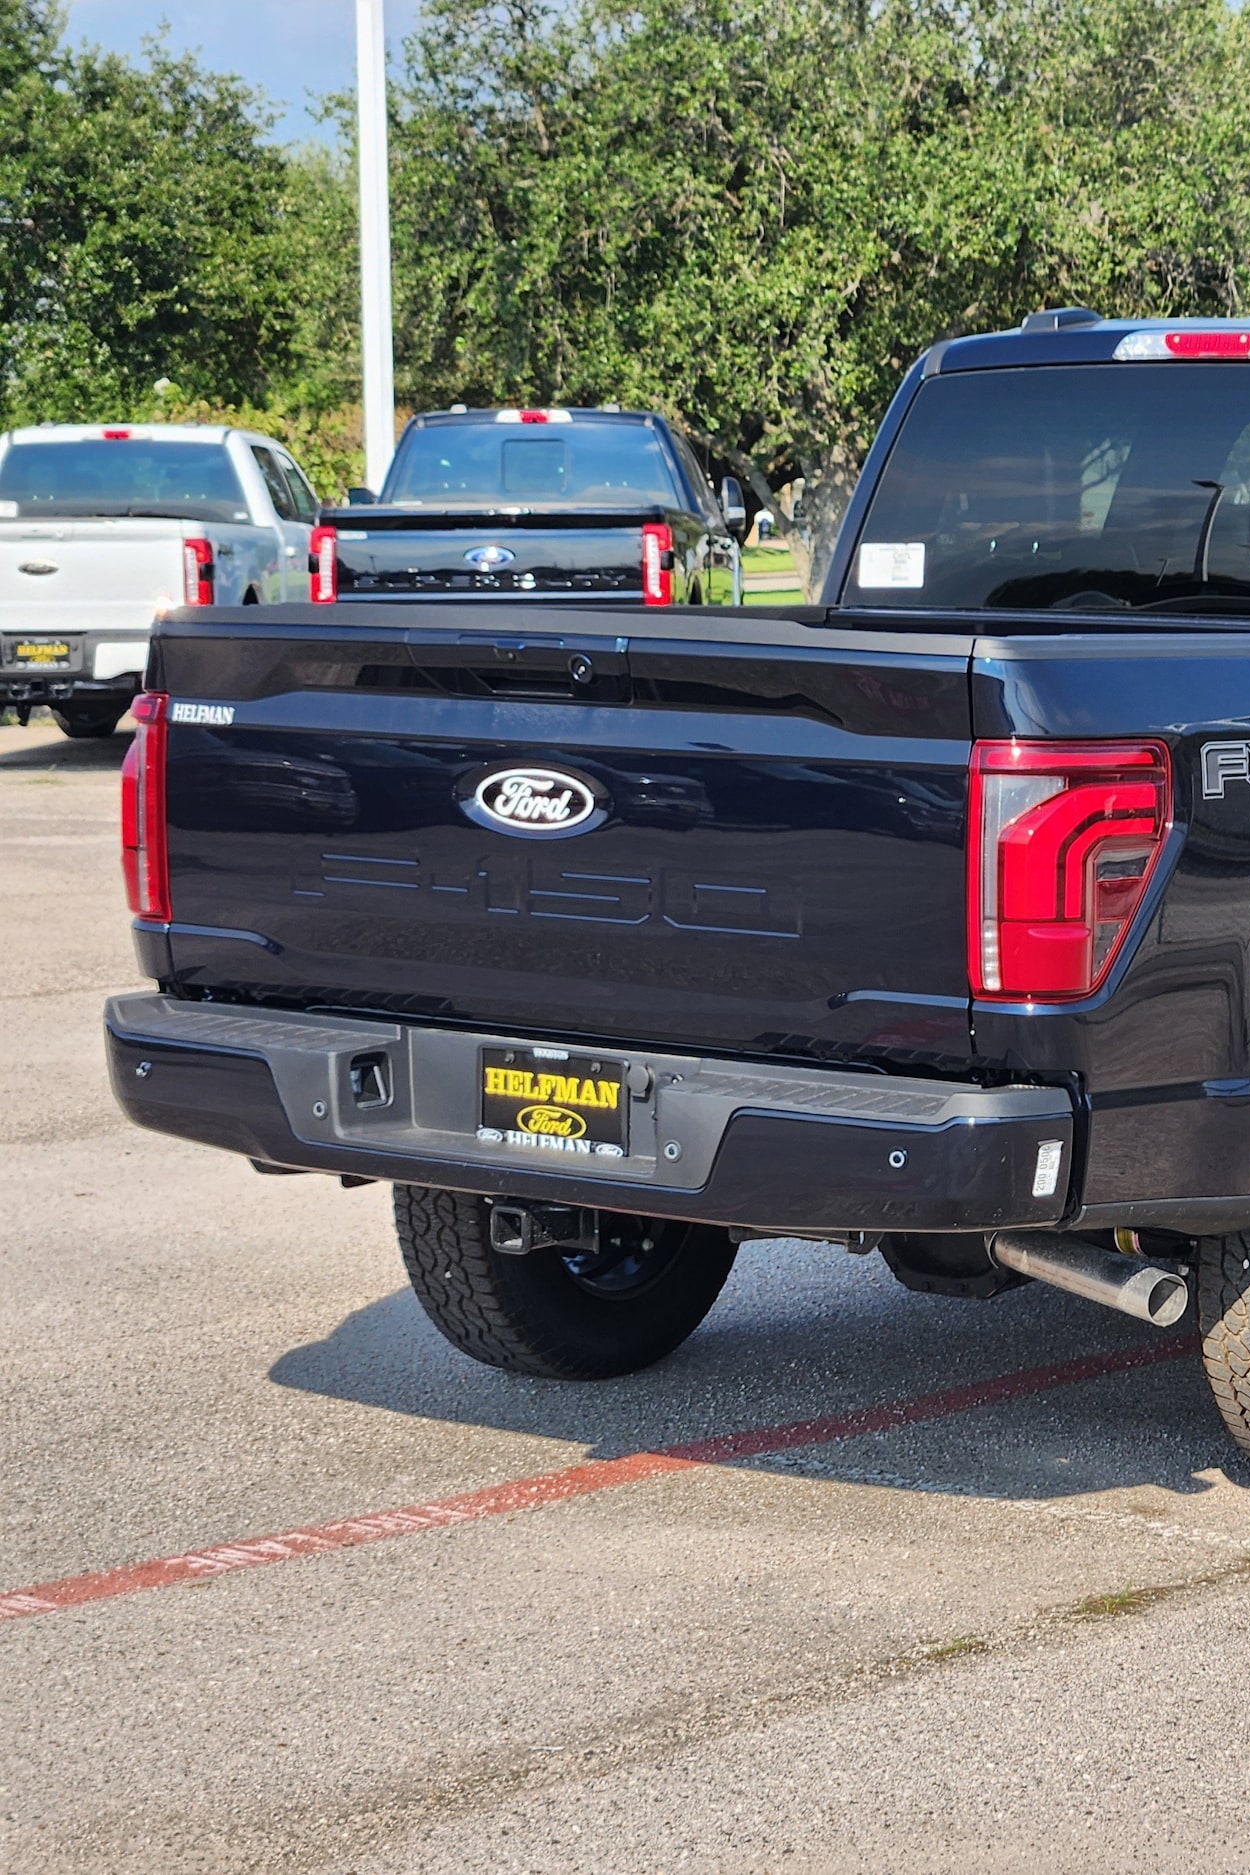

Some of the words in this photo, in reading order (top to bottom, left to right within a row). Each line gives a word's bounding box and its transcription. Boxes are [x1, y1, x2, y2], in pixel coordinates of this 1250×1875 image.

[171, 702, 235, 725] HELFMAN
[494, 776, 573, 821] Ford
[291, 849, 803, 939] F-150
[484, 1066, 621, 1109] HELFMAN
[527, 1108, 573, 1137] Ford
